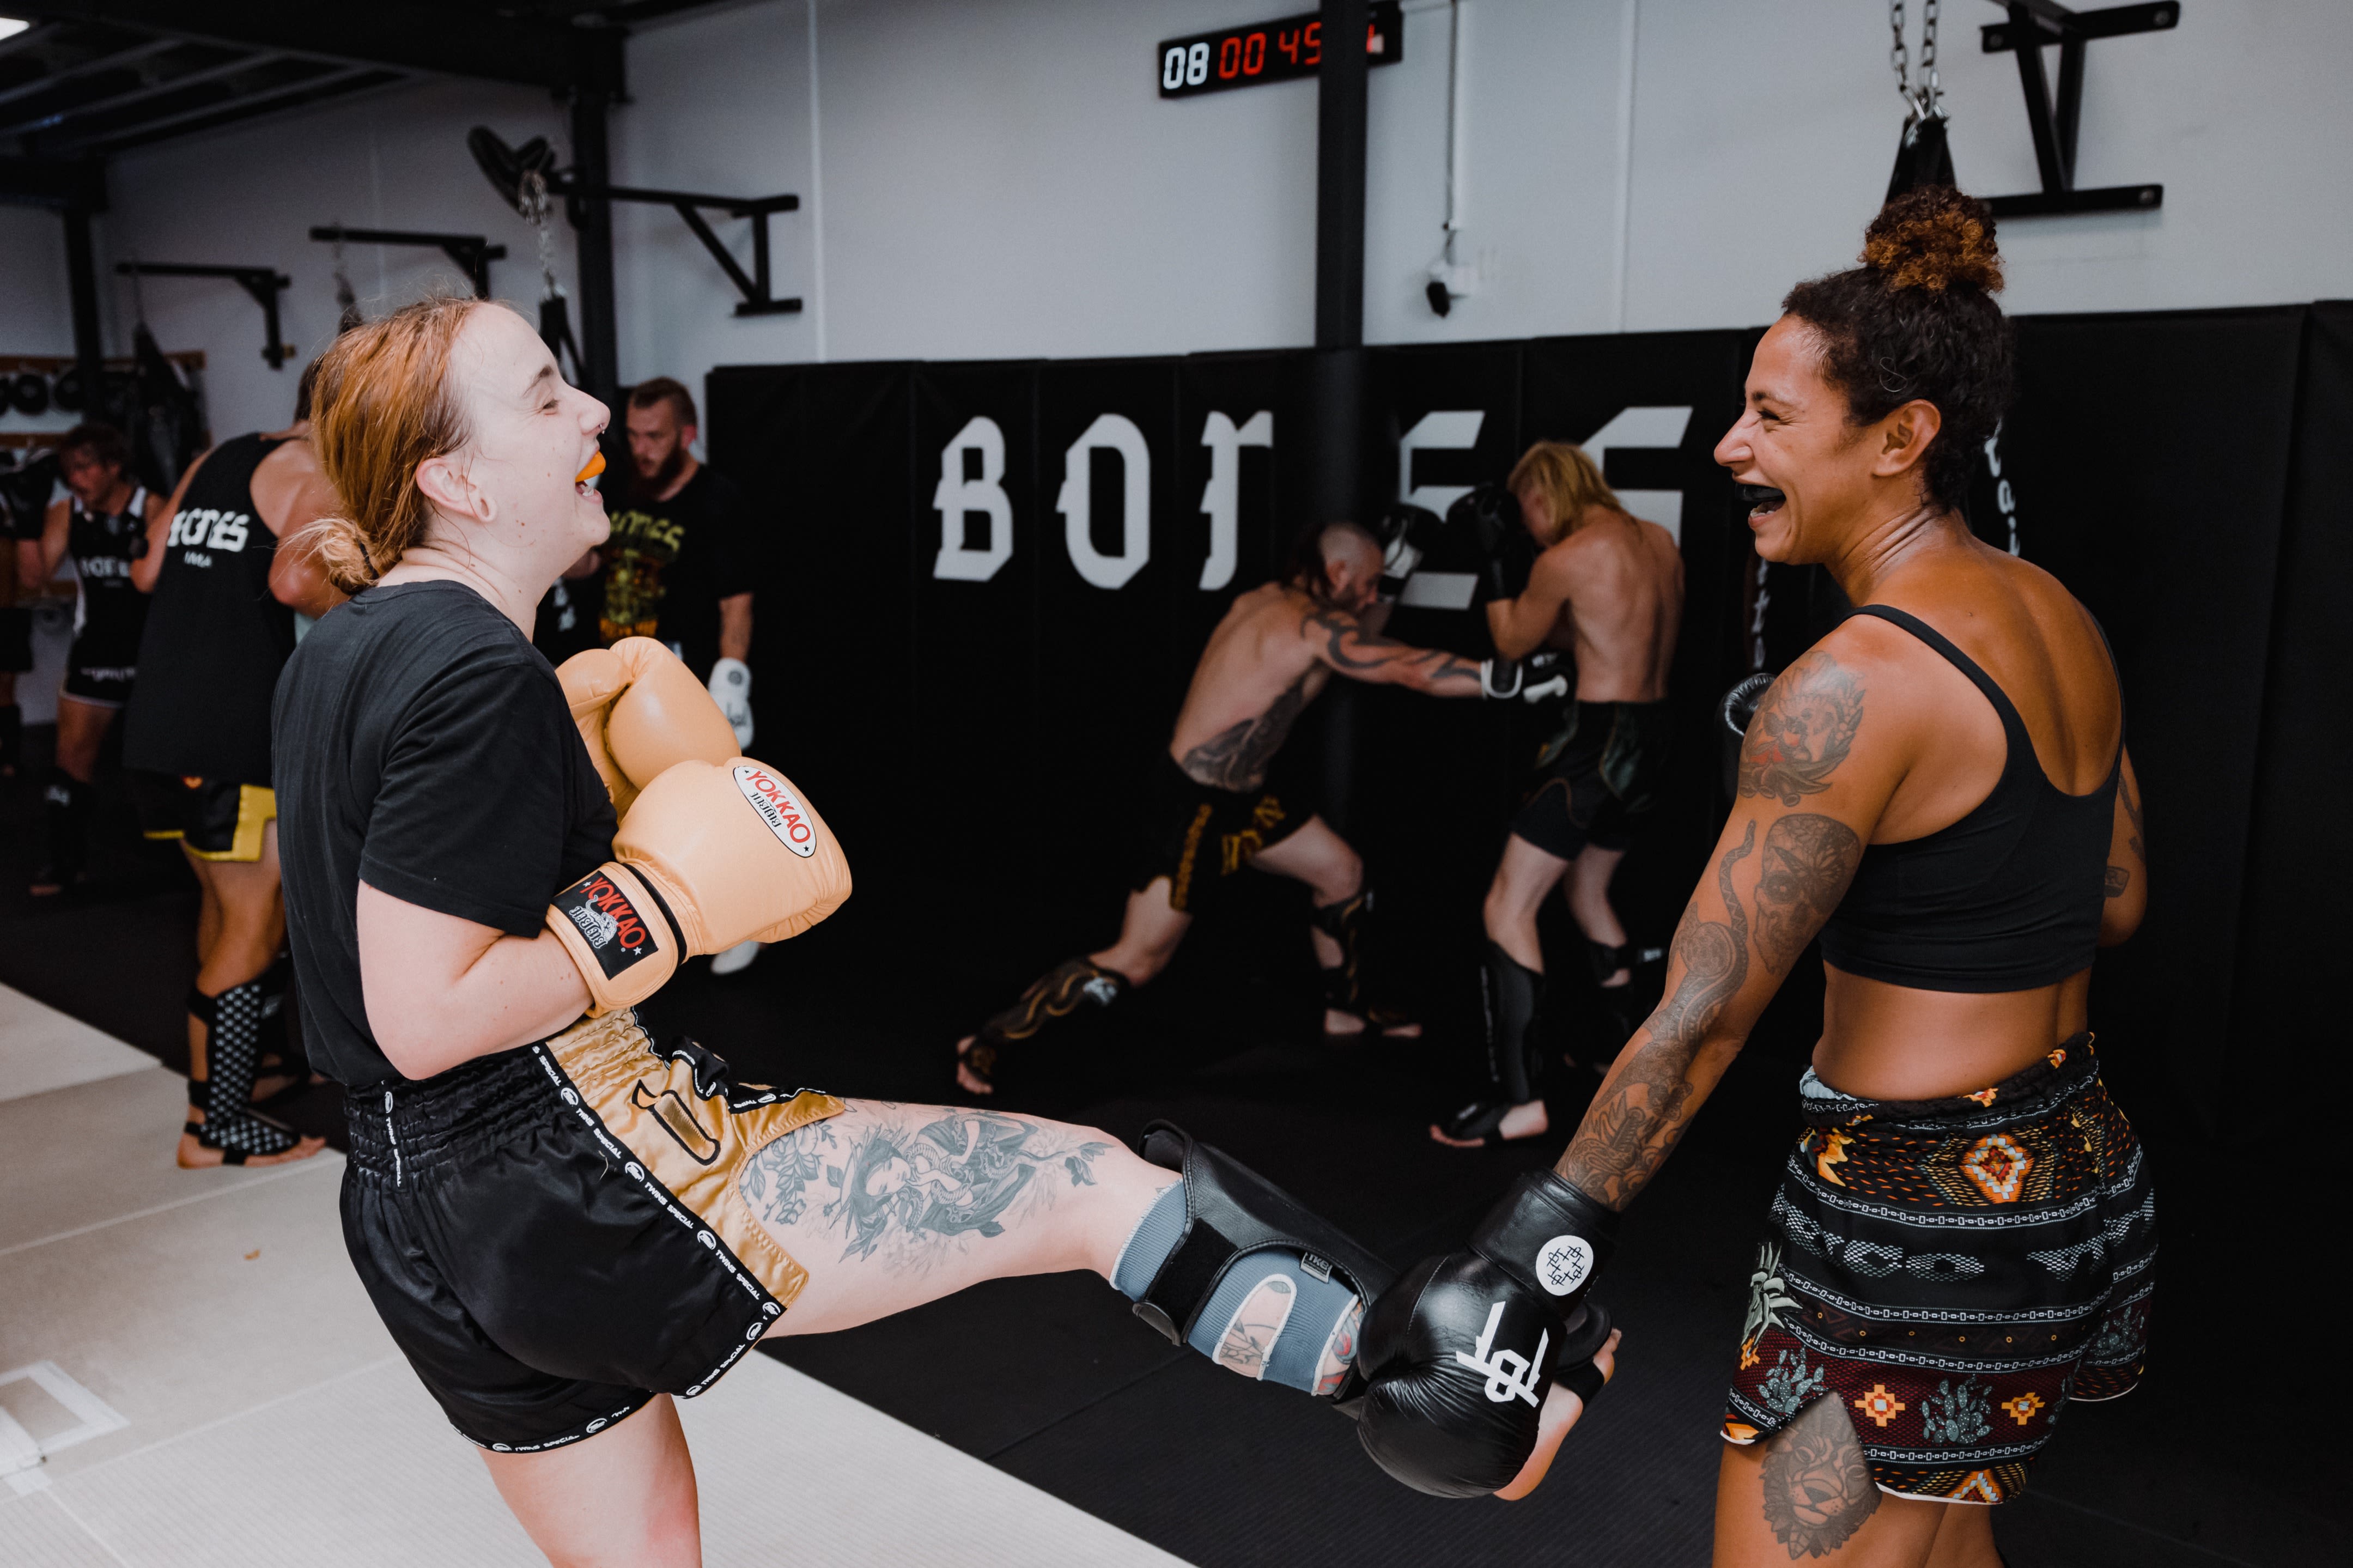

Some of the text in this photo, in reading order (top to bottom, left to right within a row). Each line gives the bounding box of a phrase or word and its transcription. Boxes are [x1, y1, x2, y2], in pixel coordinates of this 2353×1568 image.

[1163, 42, 1210, 90] 08
[1218, 32, 1267, 80] 00
[745, 770, 811, 843] YOKKAO
[579, 877, 646, 949] YOKKAO
[538, 1055, 562, 1086] SPECIAL
[575, 1108, 622, 1159] TWINS SPECIAL
[645, 1181, 694, 1230] TWINS SPECIAL
[715, 1249, 761, 1300] TWINS SPECIAL
[701, 1368, 720, 1385] TWINS
